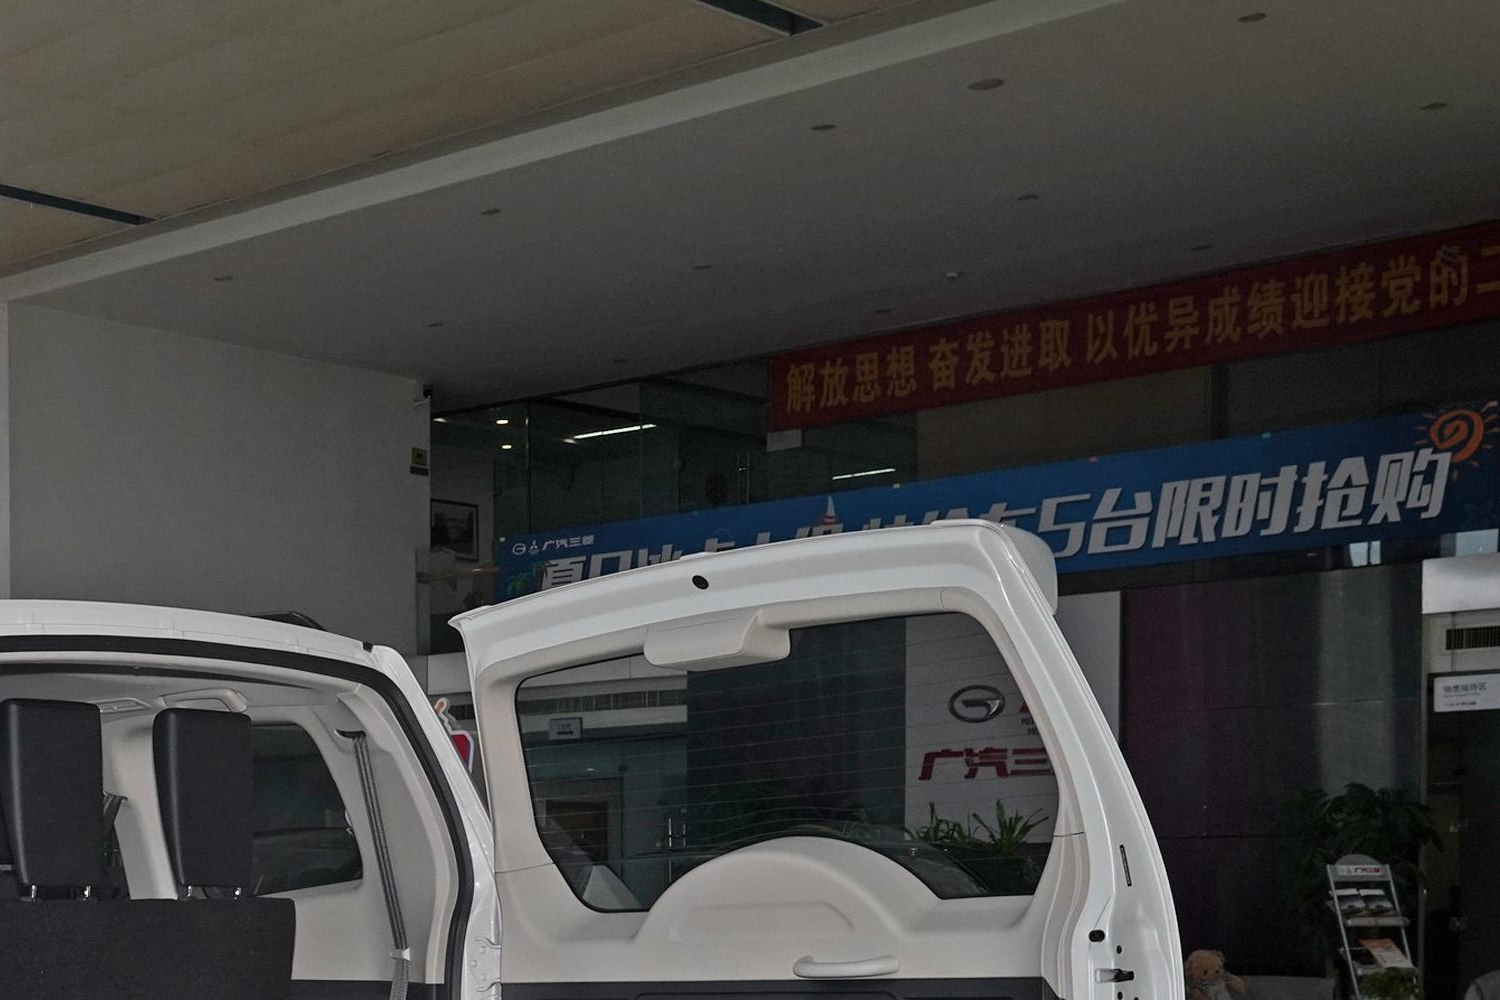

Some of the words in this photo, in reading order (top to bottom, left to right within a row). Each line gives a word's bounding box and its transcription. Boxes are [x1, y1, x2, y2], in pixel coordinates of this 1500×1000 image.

[786, 344, 917, 413] 解放思想
[928, 319, 1072, 392] 奋发进取
[918, 747, 1056, 781] 广汽三
